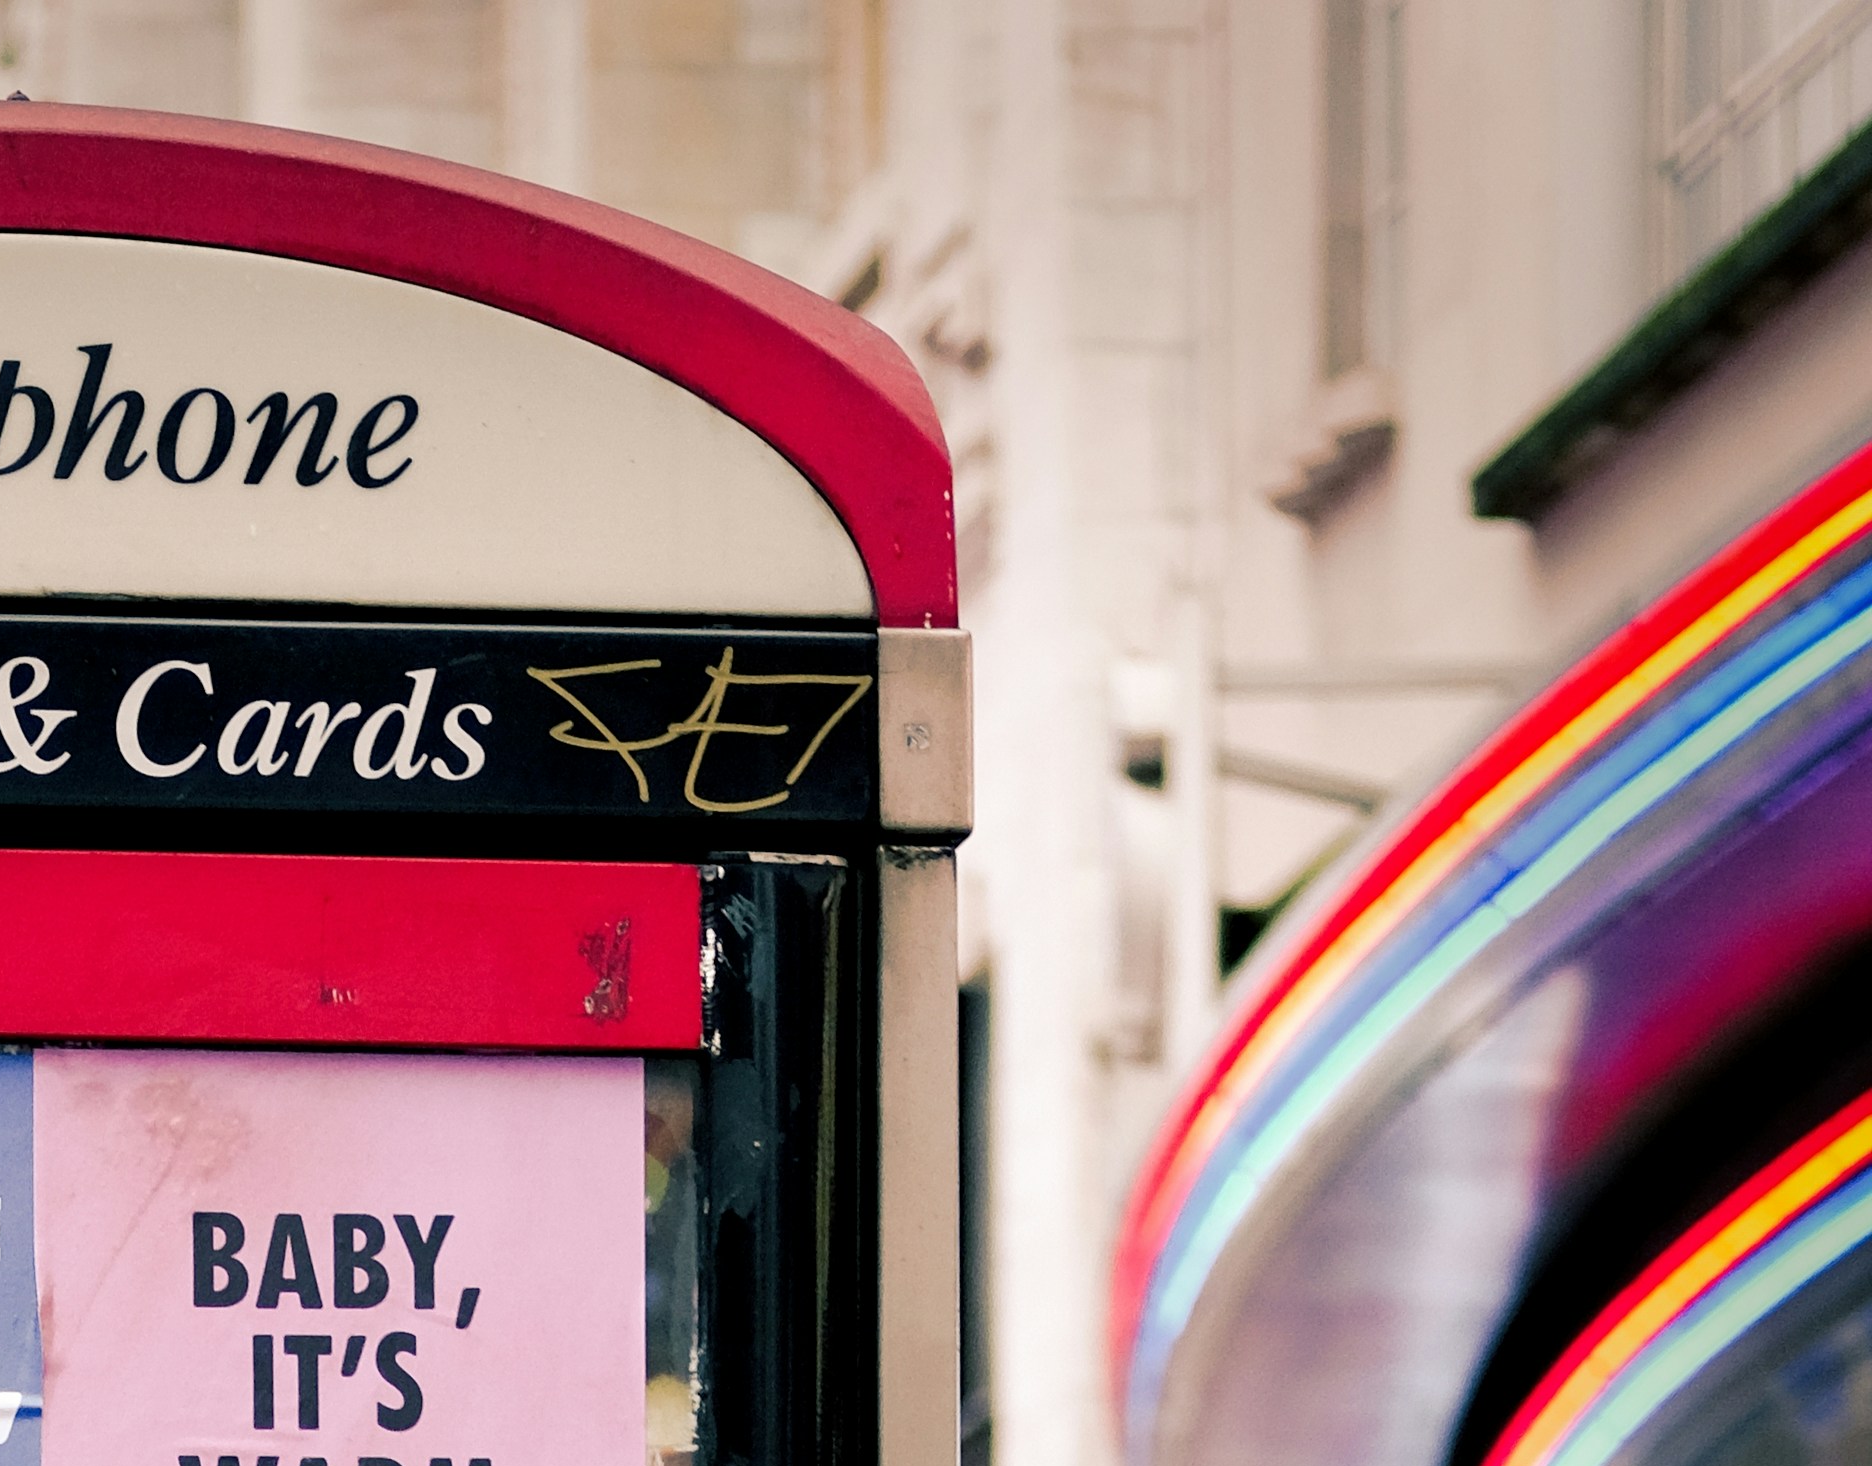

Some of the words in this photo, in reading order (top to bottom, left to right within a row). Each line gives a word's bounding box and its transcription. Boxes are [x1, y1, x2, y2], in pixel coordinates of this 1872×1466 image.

[116, 658, 493, 782] Cards
[192, 1210, 481, 1330] BABY,
[252, 1331, 424, 1432] IT'S
